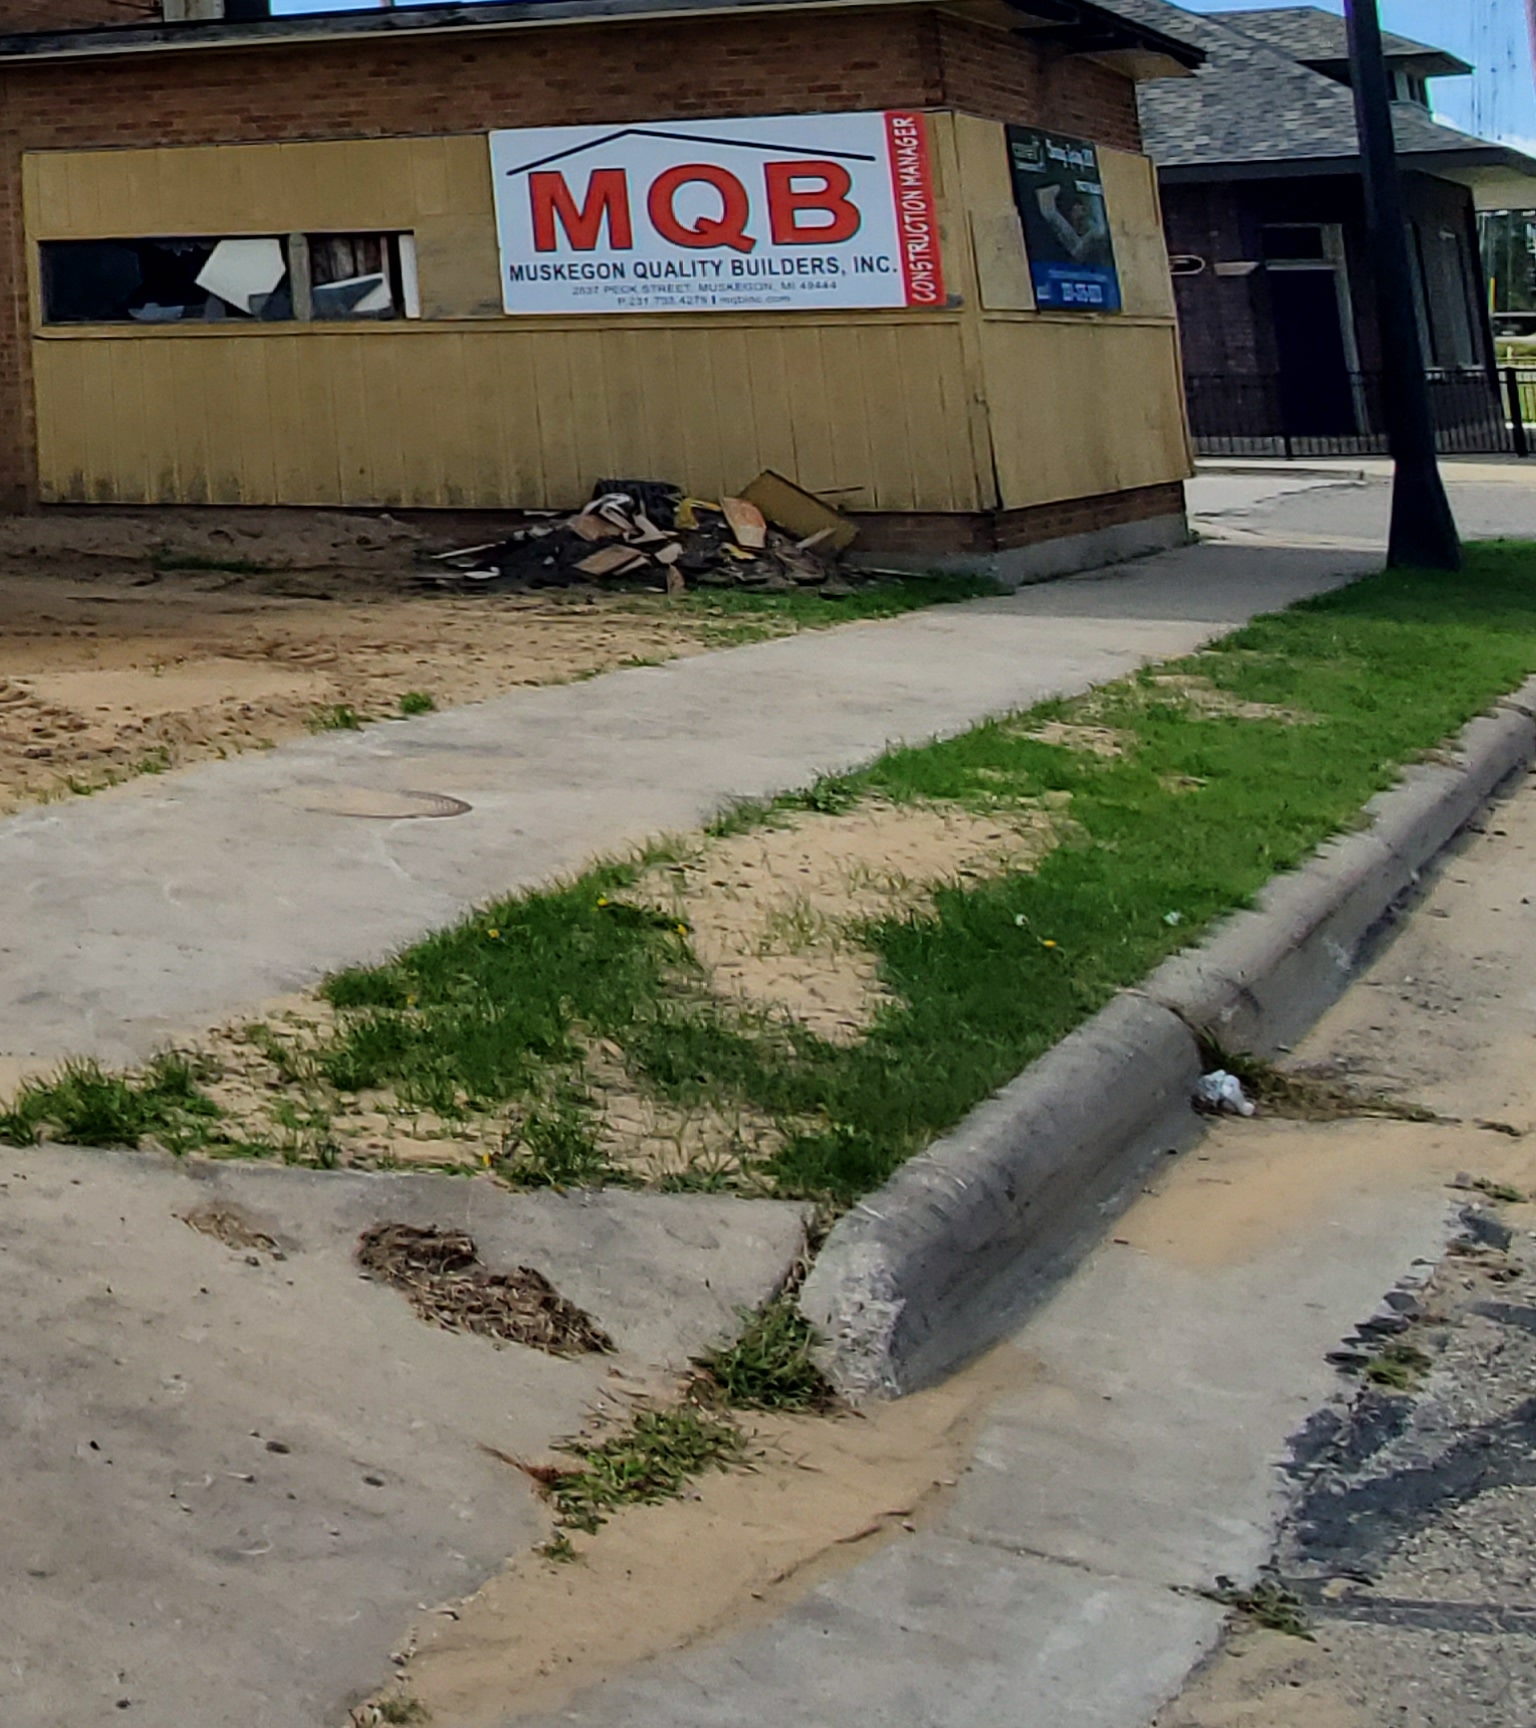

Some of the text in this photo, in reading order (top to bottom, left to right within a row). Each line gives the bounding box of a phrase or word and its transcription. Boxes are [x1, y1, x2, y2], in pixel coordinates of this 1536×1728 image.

[528, 159, 862, 254] MQB
[893, 116, 937, 302] CONSTRUCTION MANAGER
[510, 255, 898, 282] MUSKEGON QUALITY BUILDERS, INC.
